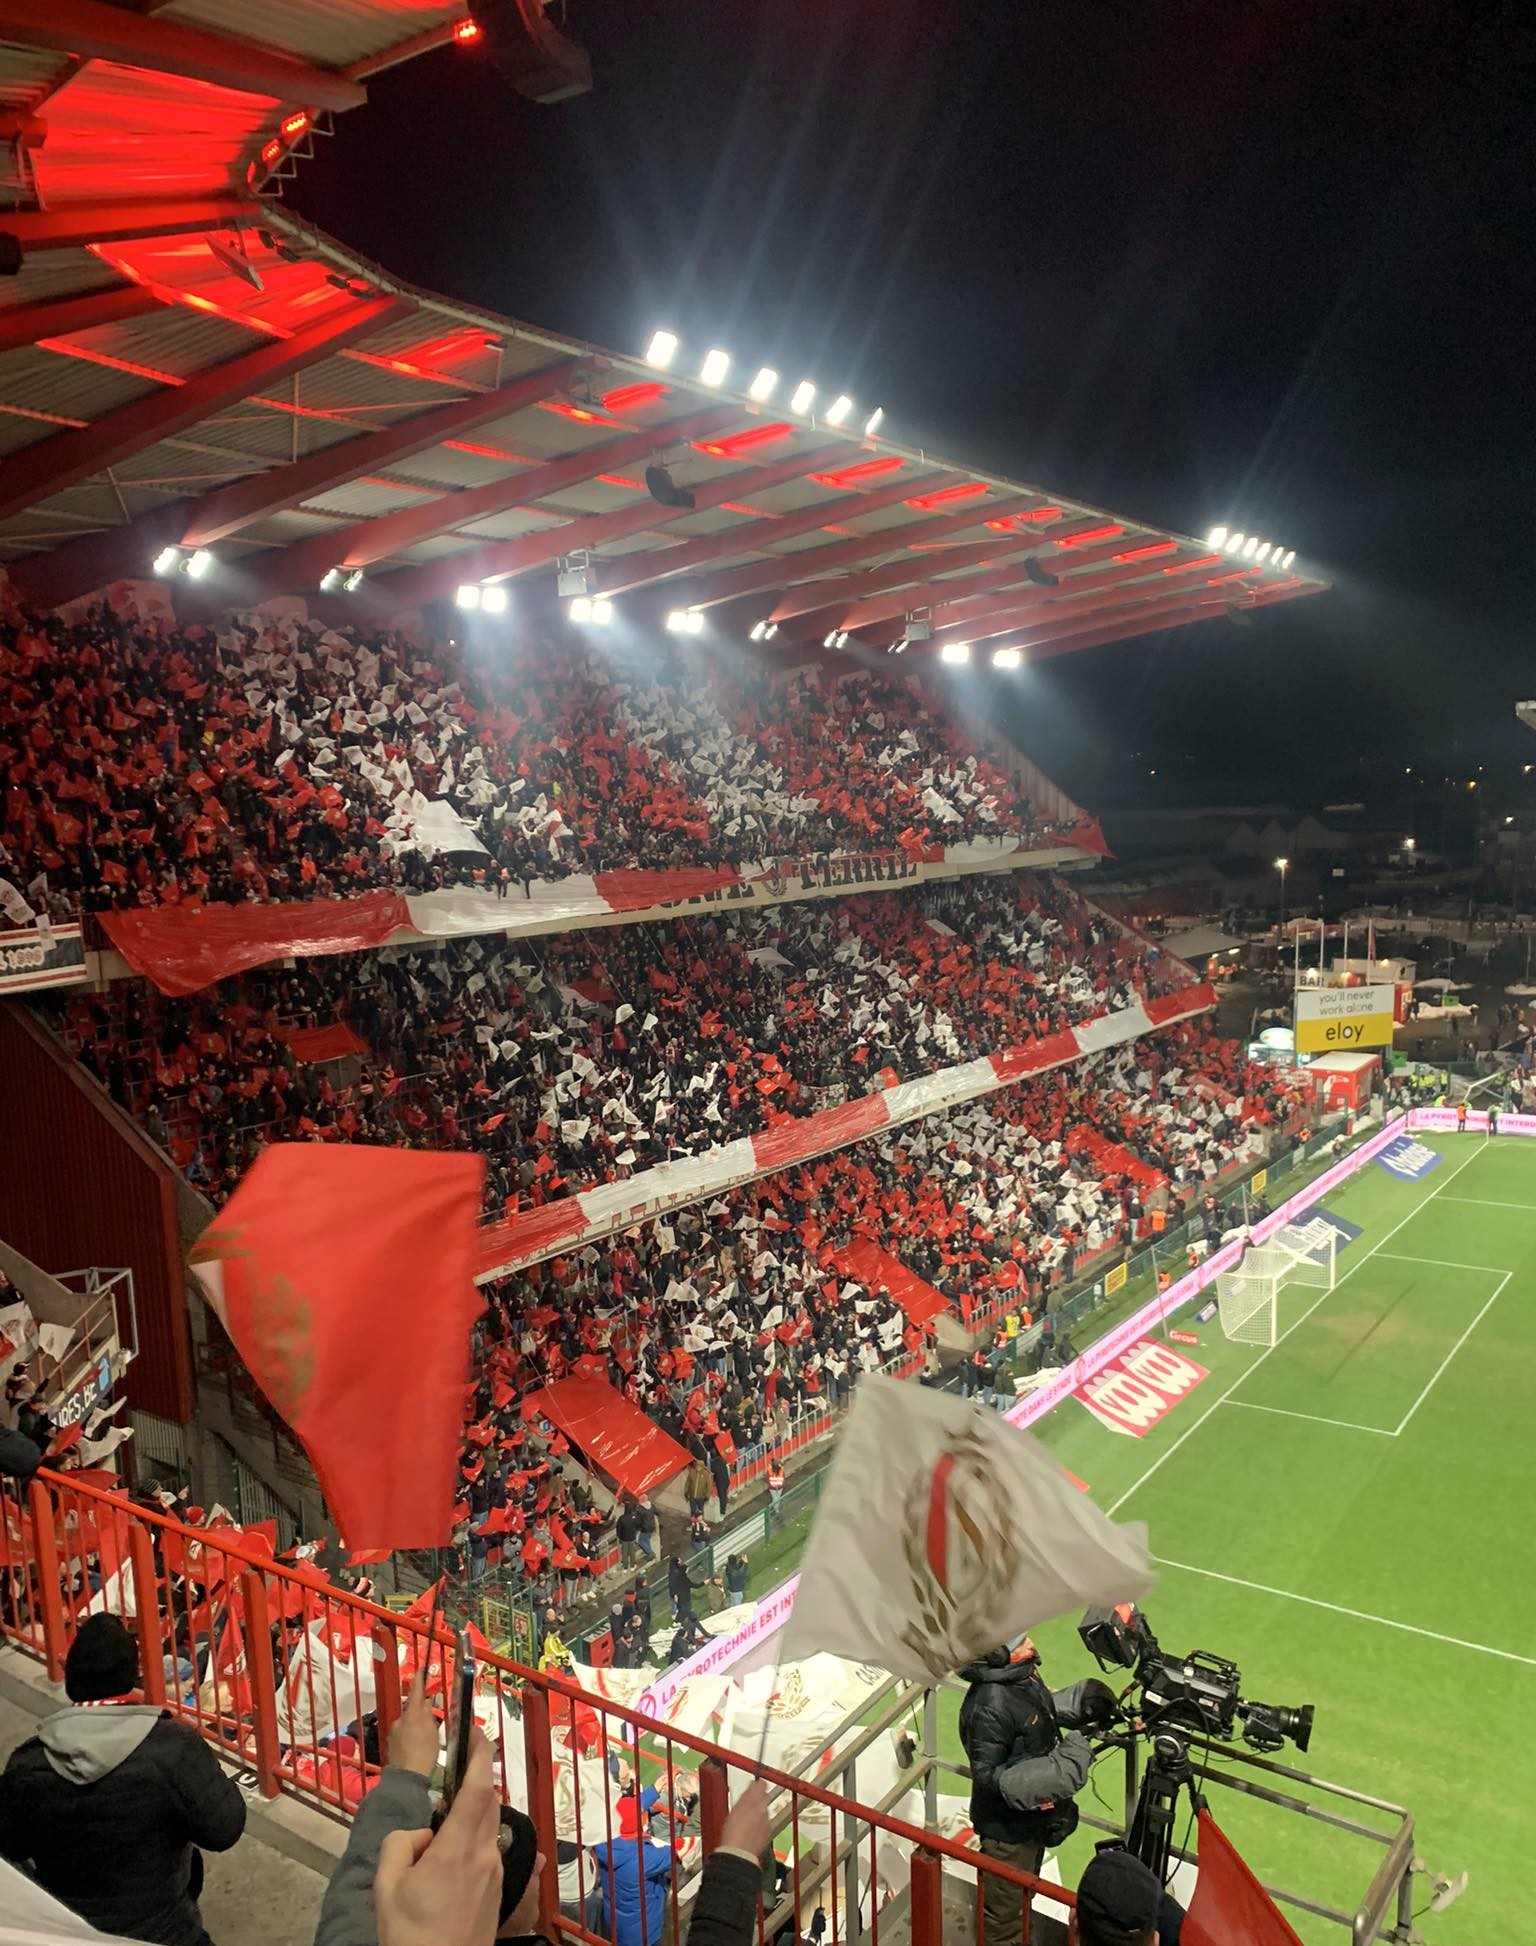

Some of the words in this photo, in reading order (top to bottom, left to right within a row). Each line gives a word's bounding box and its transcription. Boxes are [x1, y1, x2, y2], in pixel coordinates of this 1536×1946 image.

[1300, 975, 1325, 988] BAR
[1319, 991, 1345, 1004] you'll
[1346, 989, 1375, 1001] never
[1319, 1005, 1344, 1016] work
[1346, 1002, 1374, 1014] alone
[1325, 1021, 1365, 1043] eloy
[1168, 1329, 1198, 1344] Circus
[662, 1684, 677, 1705] LA
[758, 1606, 779, 1629] EST
